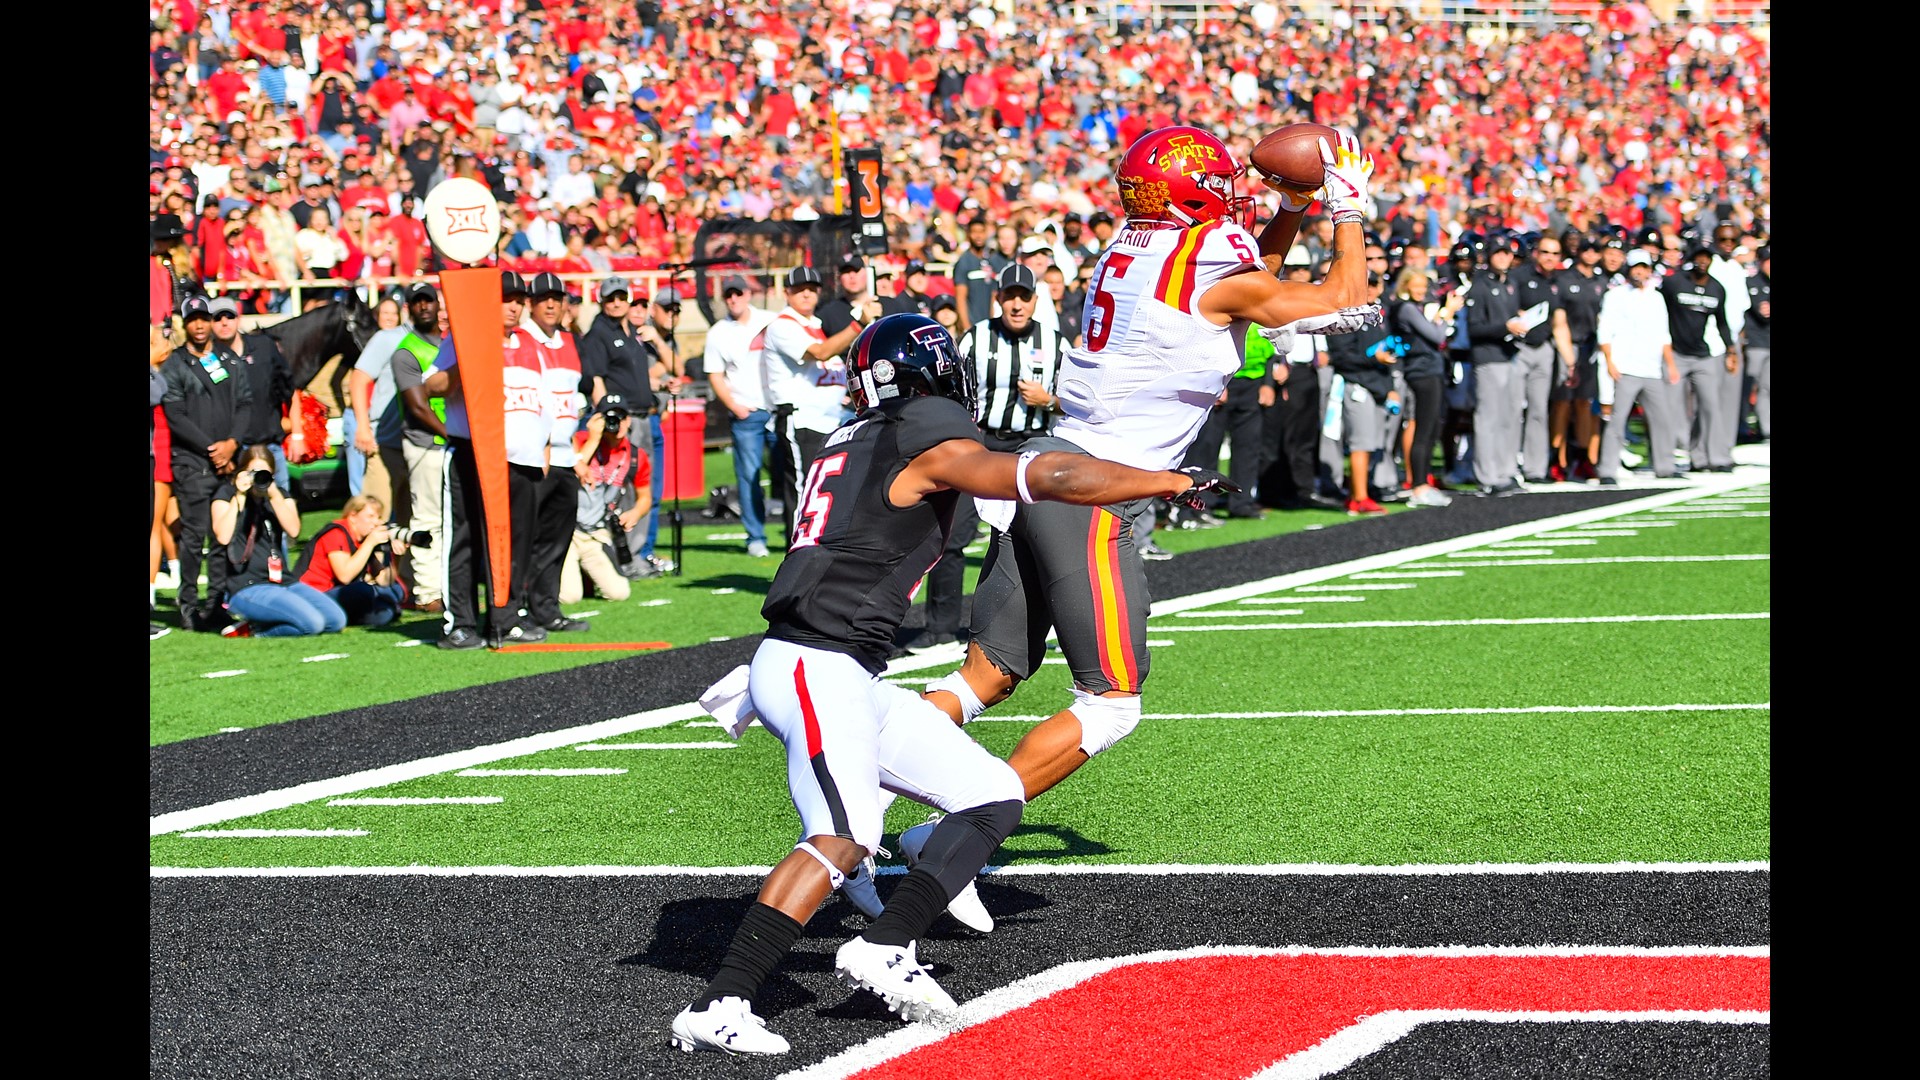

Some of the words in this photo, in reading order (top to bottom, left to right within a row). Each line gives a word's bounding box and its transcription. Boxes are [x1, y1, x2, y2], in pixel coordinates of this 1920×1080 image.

[1158, 144, 1218, 172] STATE
[858, 159, 881, 218] 3
[1226, 233, 1255, 264] 5
[1087, 251, 1135, 352] 5
[788, 451, 848, 553] 15
